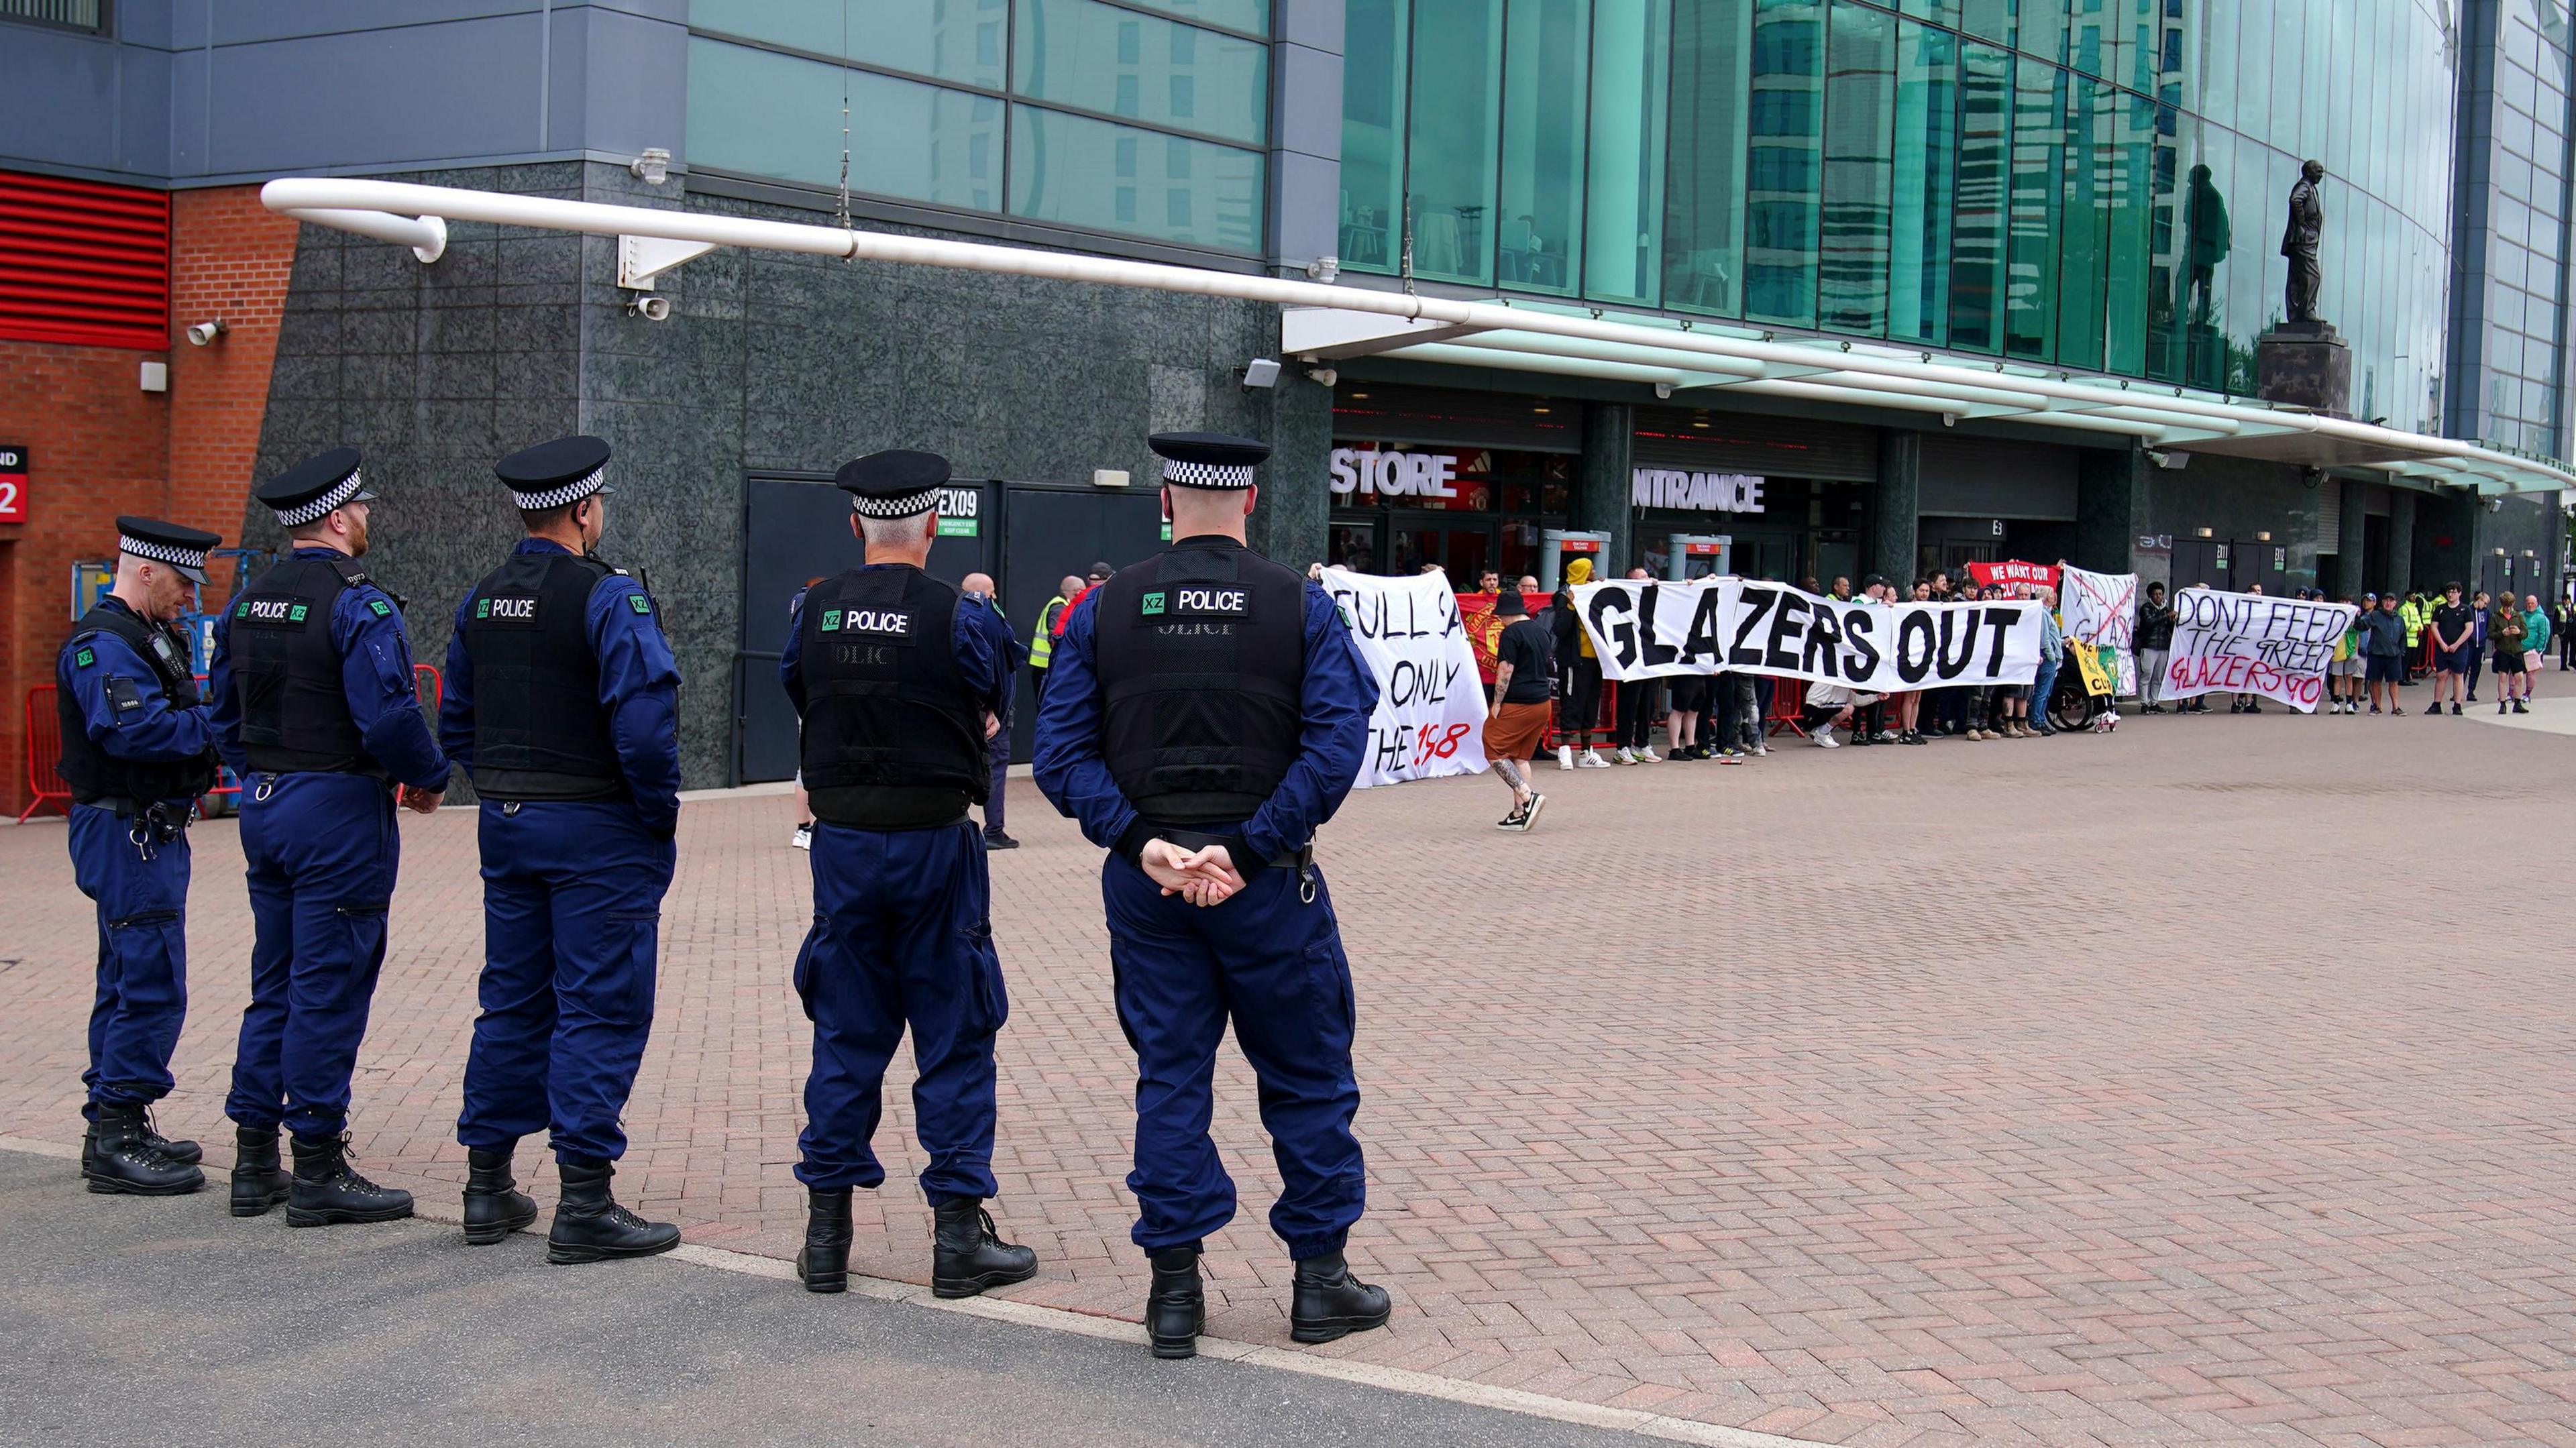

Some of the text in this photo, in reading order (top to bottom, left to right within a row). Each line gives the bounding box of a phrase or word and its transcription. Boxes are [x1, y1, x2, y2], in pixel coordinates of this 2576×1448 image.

[1330, 447, 1457, 498] STORE
[1631, 468, 1764, 513] NTRANCE
[938, 490, 977, 516] EX09
[1992, 520, 2002, 536] E3
[1990, 563, 2048, 581] WE WANT OUR
[251, 601, 288, 618] POLICE
[291, 608, 305, 618] XZ
[374, 603, 389, 612] XZ
[478, 599, 535, 617] XZ POLICE
[633, 599, 648, 609] XZ
[1144, 591, 1244, 611] XZ POLICE
[824, 611, 908, 633] XZ POLICE
[2176, 592, 2347, 643] DONT FEED
[1589, 586, 1880, 683] GLAZERS
[1897, 608, 2021, 683] OUT
[79, 652, 91, 661] XZ
[2188, 628, 2335, 672] THE GREED
[1391, 659, 1460, 708] ONLY
[2171, 656, 2284, 692] GLAZERS
[2286, 672, 2321, 704] GO
